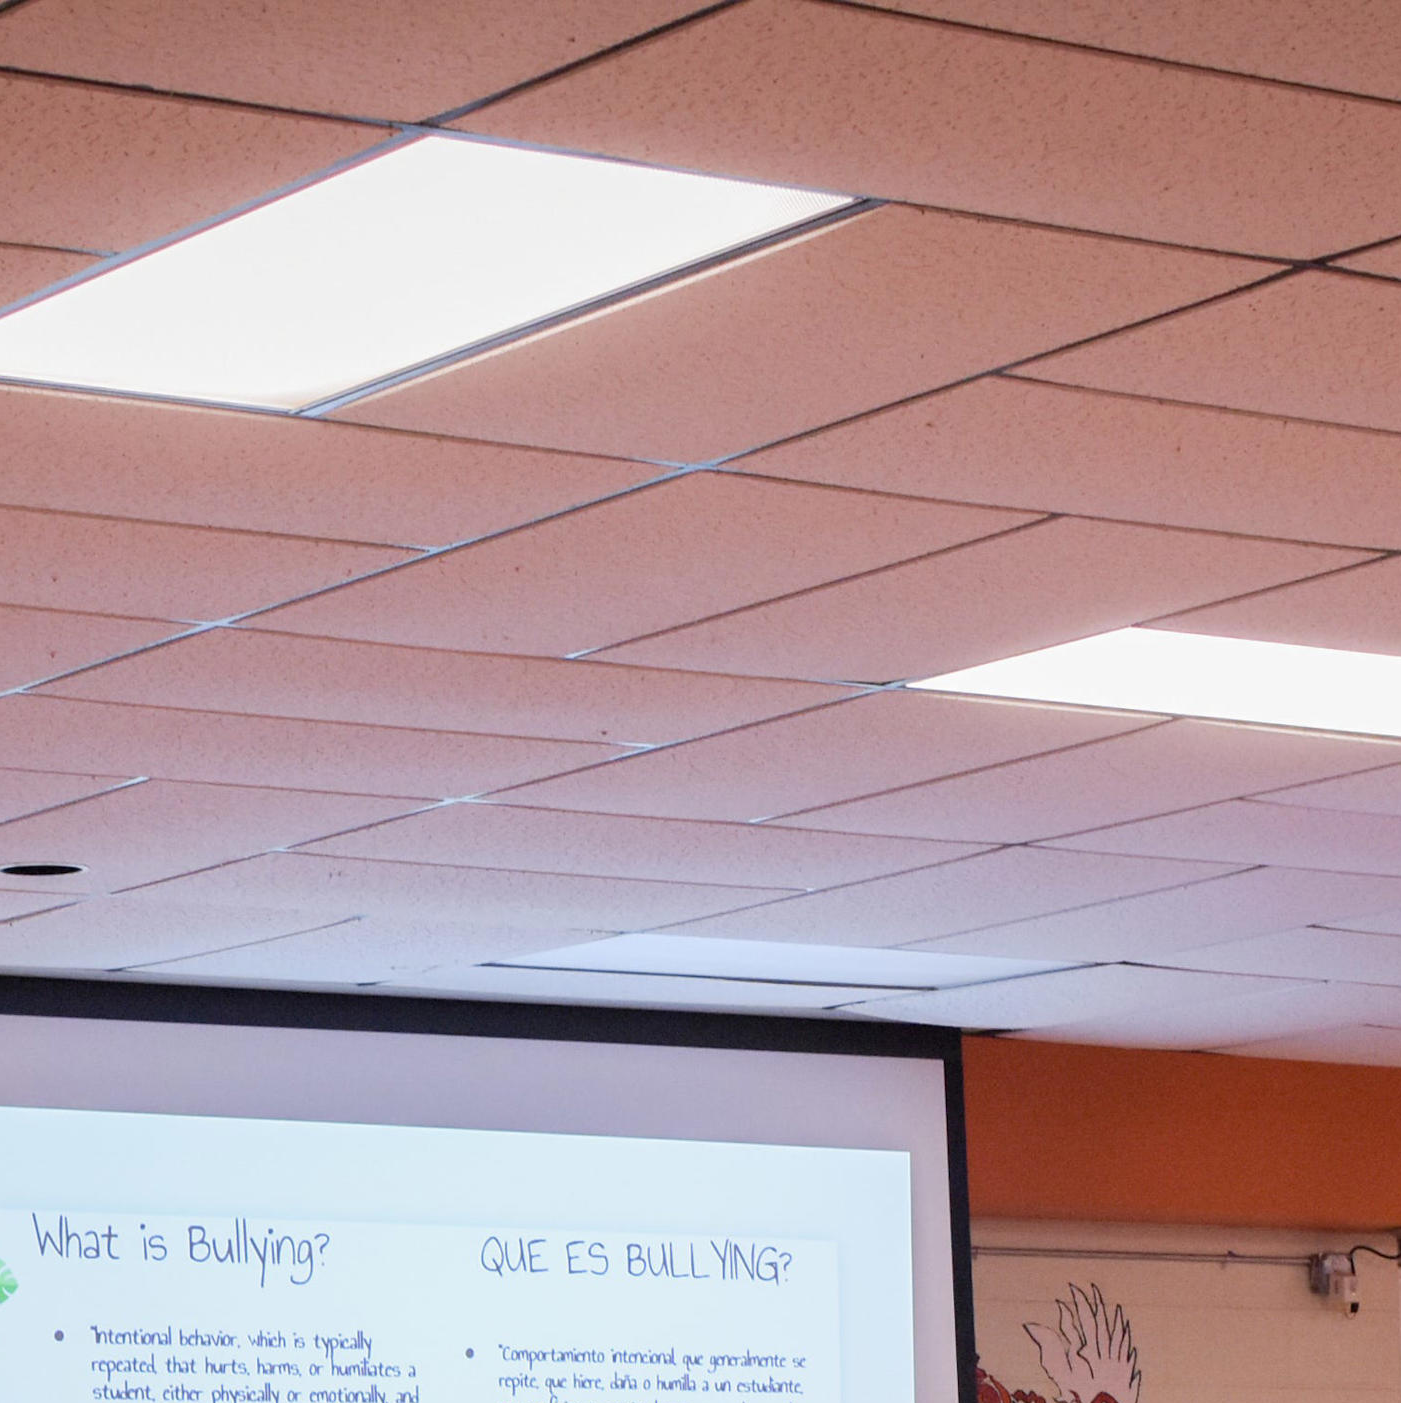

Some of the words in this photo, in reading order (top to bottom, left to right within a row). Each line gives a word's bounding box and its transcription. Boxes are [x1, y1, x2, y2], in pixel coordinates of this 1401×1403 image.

[32, 1212, 120, 1261] What
[139, 1222, 167, 1262] is
[189, 1216, 331, 1287] Bullying?
[480, 1236, 549, 1278] QUE
[565, 1240, 609, 1277] ES
[626, 1238, 793, 1286] BULLYING?
[90, 1325, 173, 1346] "Intentional
[179, 1328, 241, 1349] behavior,
[248, 1330, 286, 1348] which
[293, 1331, 306, 1349] is
[313, 1330, 372, 1360] typically
[91, 1352, 157, 1383] repeated,
[166, 1355, 197, 1374] that
[205, 1356, 250, 1376] hurts,
[256, 1357, 302, 1377] harms,
[309, 1363, 324, 1377] or
[331, 1357, 401, 1378] humiliates
[408, 1365, 417, 1378] a
[498, 1343, 605, 1371] "Comportamiento
[682, 1353, 703, 1372] que
[707, 1348, 787, 1374] generalmente
[792, 1356, 807, 1369] se
[92, 1379, 156, 1402] student,
[162, 1383, 203, 1401] either
[287, 1389, 302, 1403] or
[545, 1377, 567, 1396] que
[610, 1371, 638, 1390] daña
[643, 1379, 651, 1390] o
[656, 1373, 697, 1392] humilla
[702, 1379, 710, 1392] a
[714, 1379, 732, 1393] un
